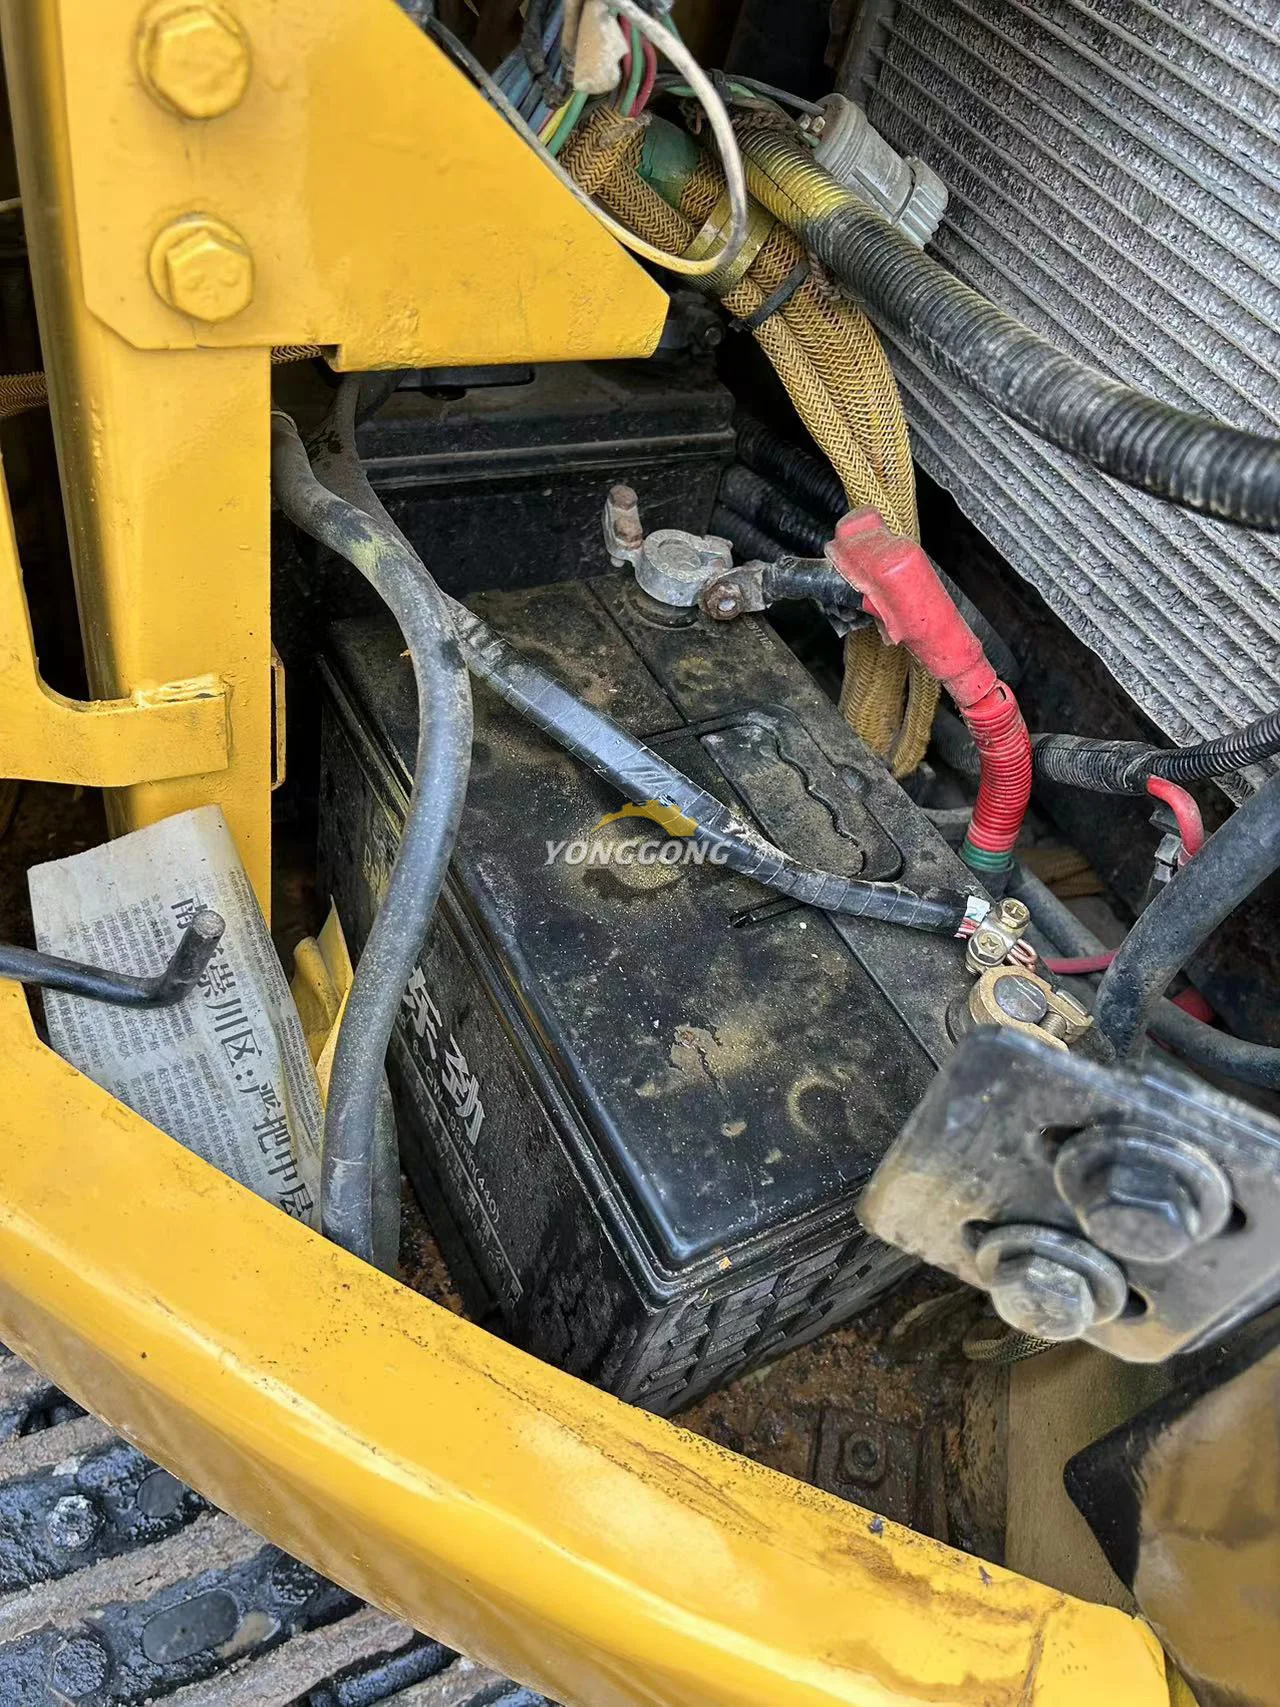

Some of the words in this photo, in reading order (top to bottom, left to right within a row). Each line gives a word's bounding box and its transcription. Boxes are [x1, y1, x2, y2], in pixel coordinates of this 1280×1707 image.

[171, 898, 314, 1217] 南崇川区：严把中层
